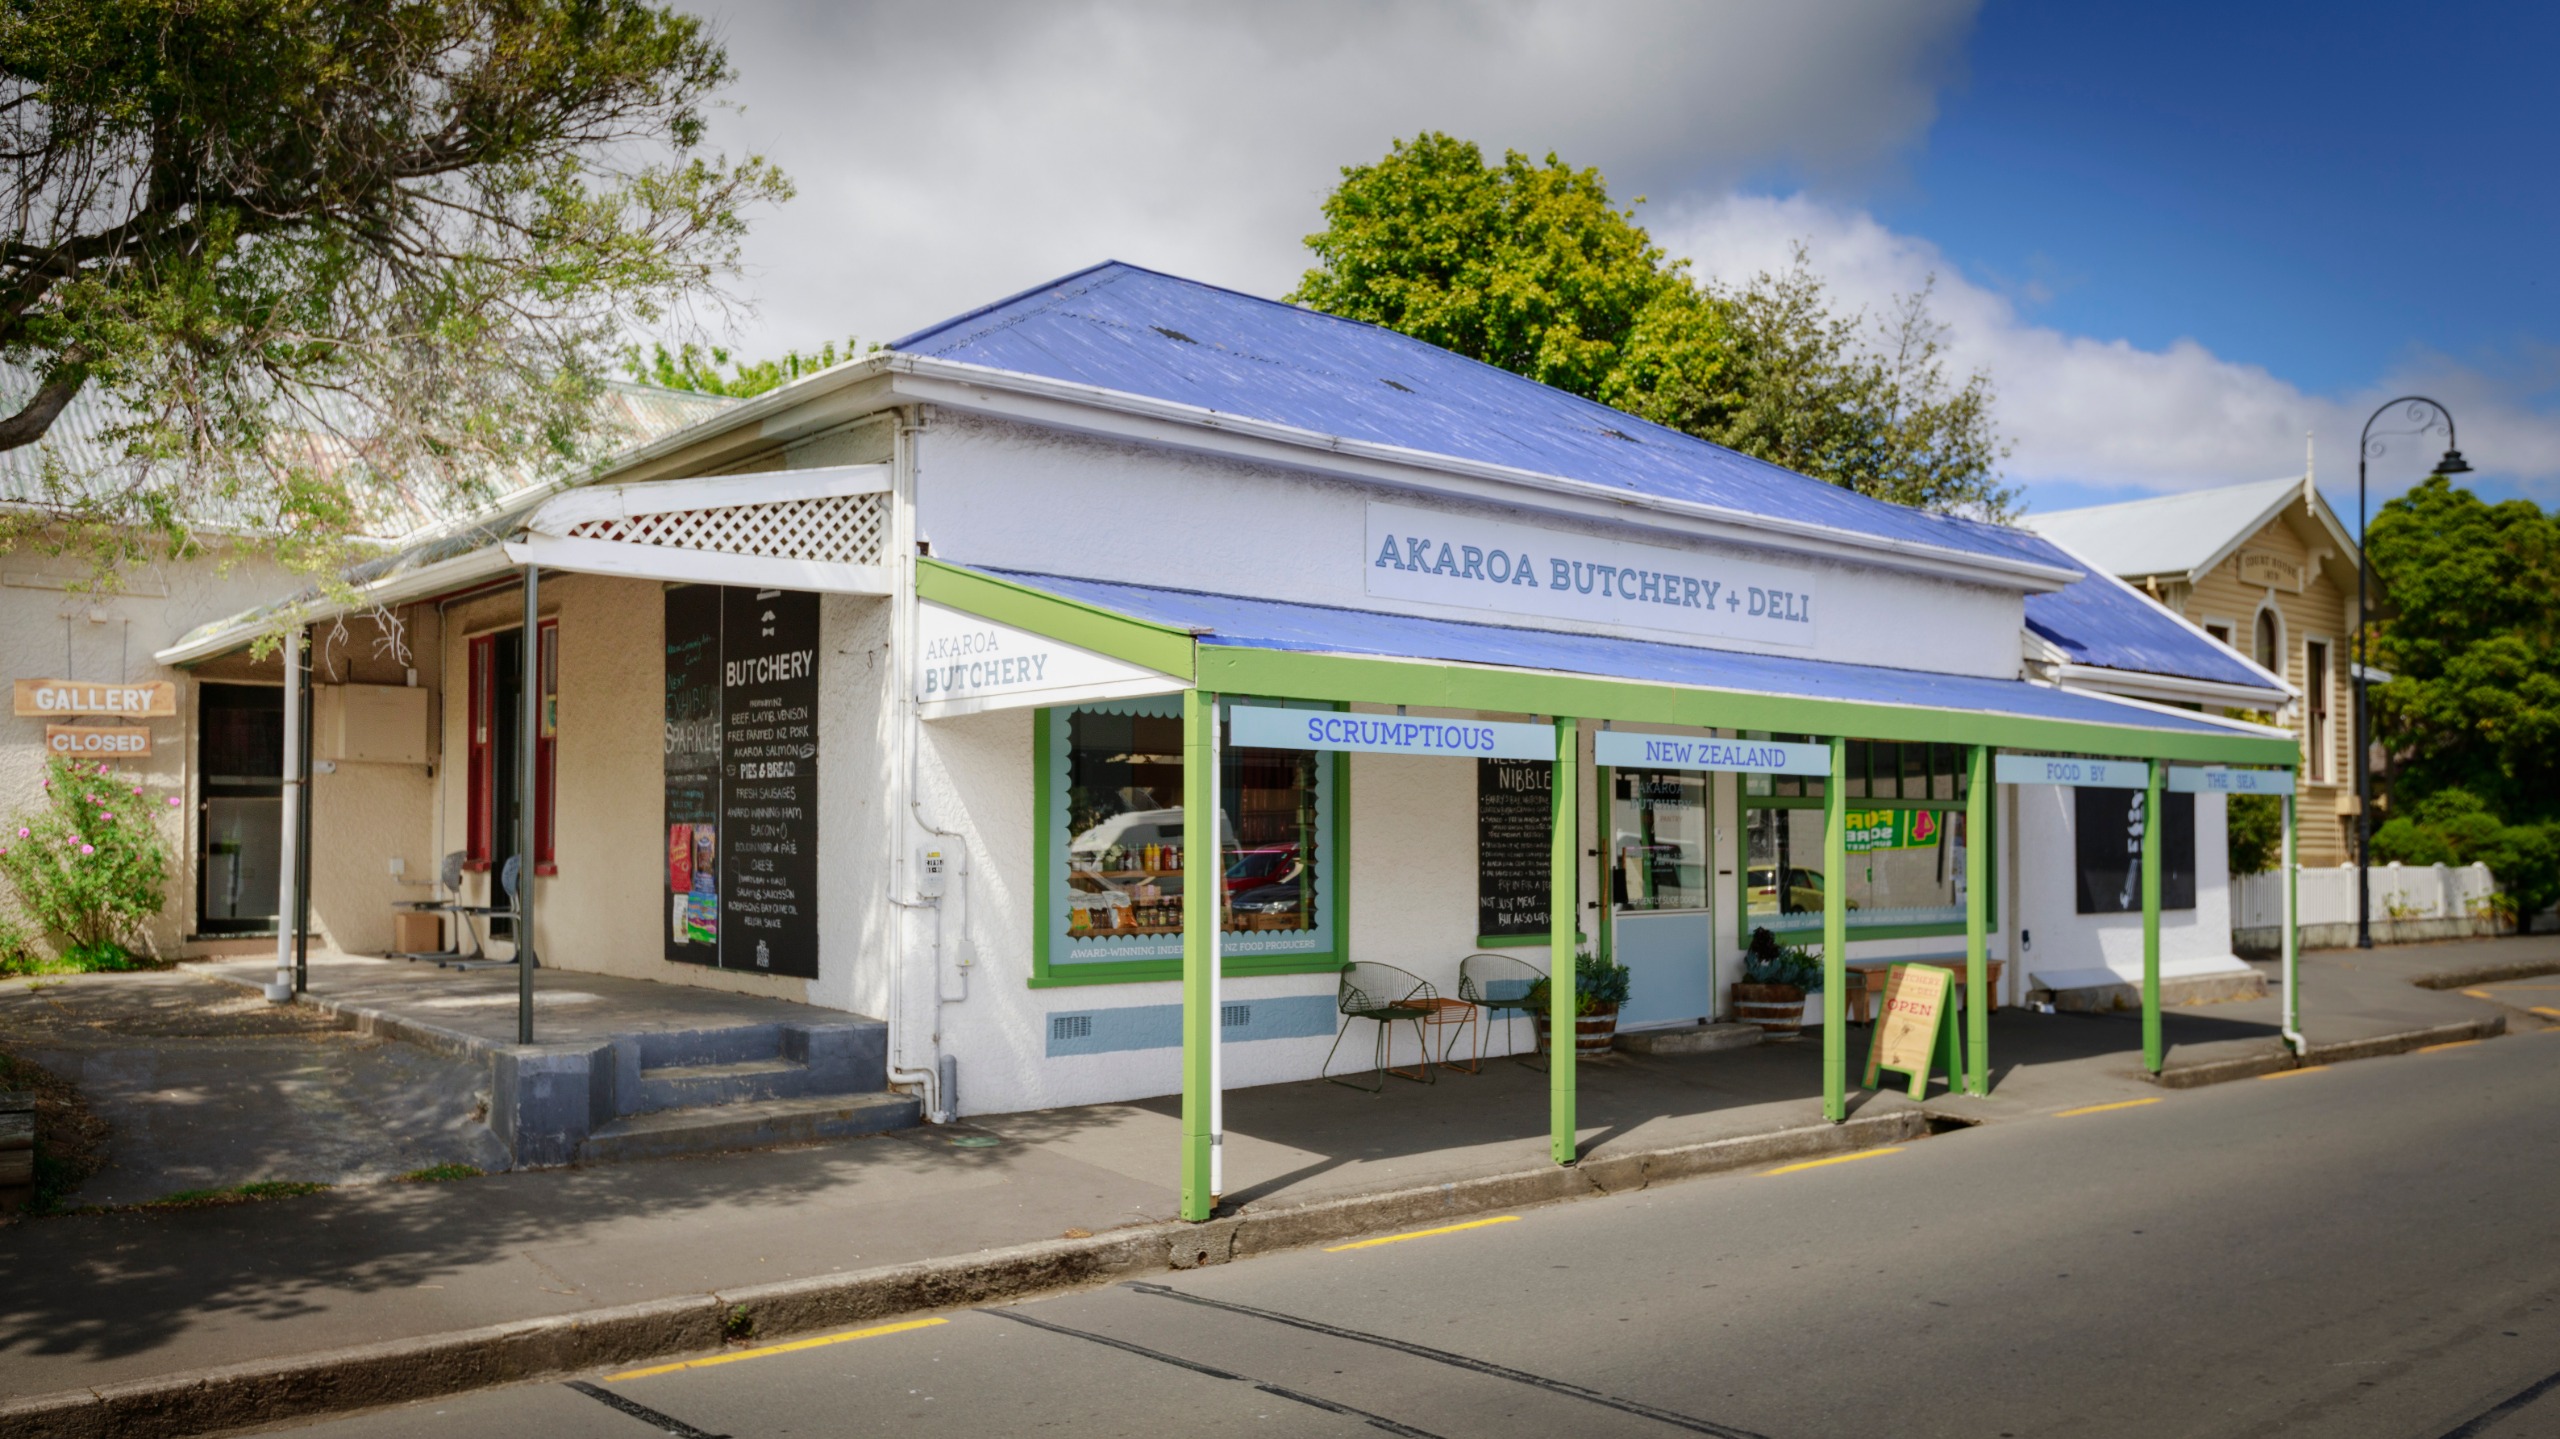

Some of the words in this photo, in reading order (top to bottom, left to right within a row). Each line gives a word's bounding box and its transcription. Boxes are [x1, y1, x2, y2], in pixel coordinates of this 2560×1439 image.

[2245, 555, 2269, 568] COURT
[2272, 557, 2297, 579] HOUSE
[1375, 534, 1539, 587] AKAROA
[1550, 557, 1721, 611] BUTCHERY
[1727, 591, 1741, 613] +
[1747, 587, 1809, 622] DELI
[926, 630, 999, 660] AKAROA
[726, 649, 813, 687] BUTCHERY
[925, 653, 1048, 693] BUTCHERY
[35, 688, 154, 711] GALLERY
[52, 734, 146, 751] CLOSED
[665, 722, 721, 754] SPARKLE
[727, 729, 744, 742] FREE
[776, 727, 788, 739] NZ
[790, 725, 809, 738] PORK
[1307, 717, 1496, 751] SCRUMPTIOUS
[734, 746, 763, 757] AKAROA
[765, 744, 799, 757] SALMON
[1646, 740, 1693, 763] NEW
[1698, 744, 1786, 768] ZEALAND
[740, 763, 757, 779] PIES
[759, 763, 766, 778] &
[766, 761, 796, 778] BREAD
[2046, 762, 2081, 780] FOOD
[2090, 765, 2106, 781] BY
[1638, 782, 1685, 794] AKAROA
[2206, 773, 2228, 789] THE
[2236, 774, 2257, 789] SEA
[736, 787, 758, 799] FRESH
[759, 786, 796, 800] SAUSAGES
[727, 807, 750, 818] AWARD
[781, 807, 802, 820] HAM
[1631, 798, 1692, 810] BUTCHERY
[750, 823, 775, 837] BACON
[750, 858, 775, 872] CHEESE
[1070, 946, 1155, 959] AWARD-WINNING
[1225, 943, 1238, 952] NZ
[1239, 942, 1264, 951] FOOD
[1265, 939, 1315, 950] PRODUCERS
[1887, 998, 1932, 1017] OPEN
